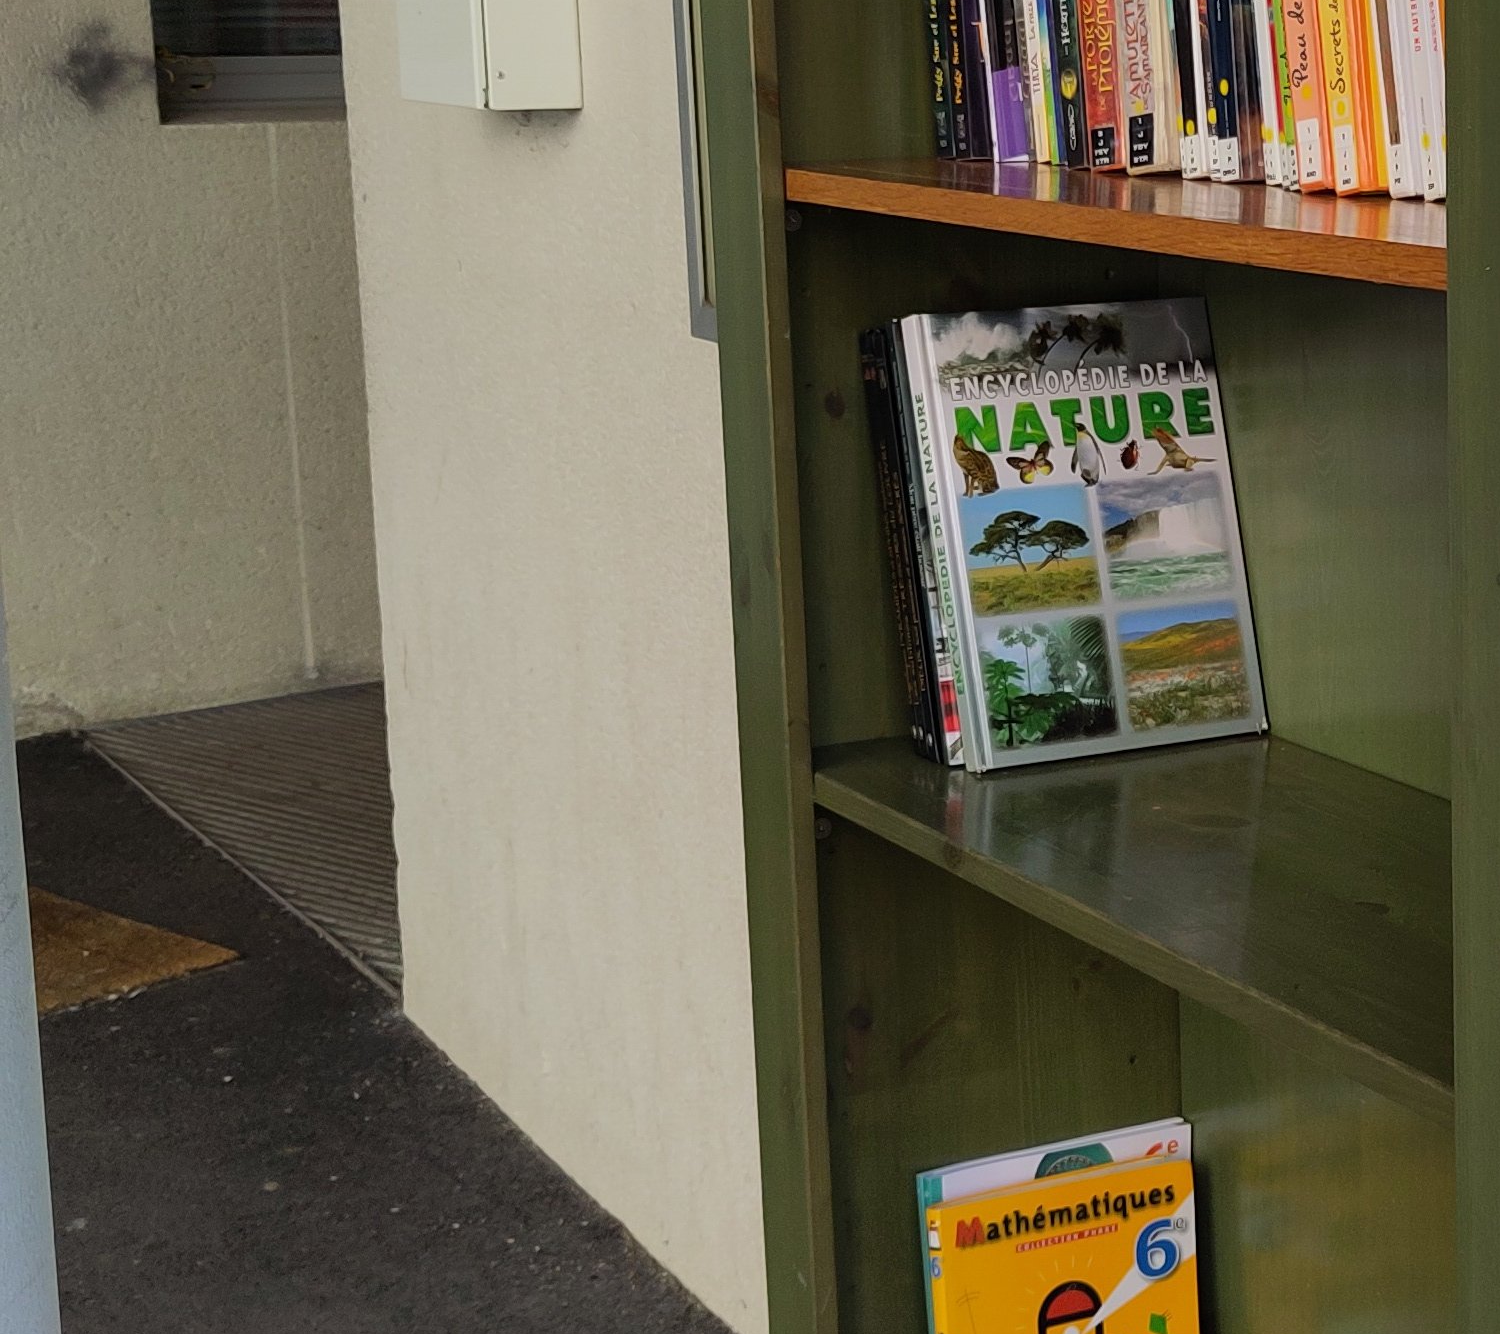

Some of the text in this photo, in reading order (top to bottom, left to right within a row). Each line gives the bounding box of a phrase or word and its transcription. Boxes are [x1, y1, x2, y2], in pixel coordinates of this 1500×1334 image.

[1285, 0, 1305, 25] de
[1288, 33, 1312, 87] Peau
[1322, 18, 1347, 95] Secrets
[950, 359, 1207, 401] ENCYCLOPÉDIE DE LA
[913, 392, 935, 474] NATURE
[953, 387, 1216, 453] NATURE
[926, 480, 939, 505] LA
[930, 511, 943, 538] DE
[955, 1184, 1175, 1248] Mathématiques
[930, 1257, 942, 1279] 6
